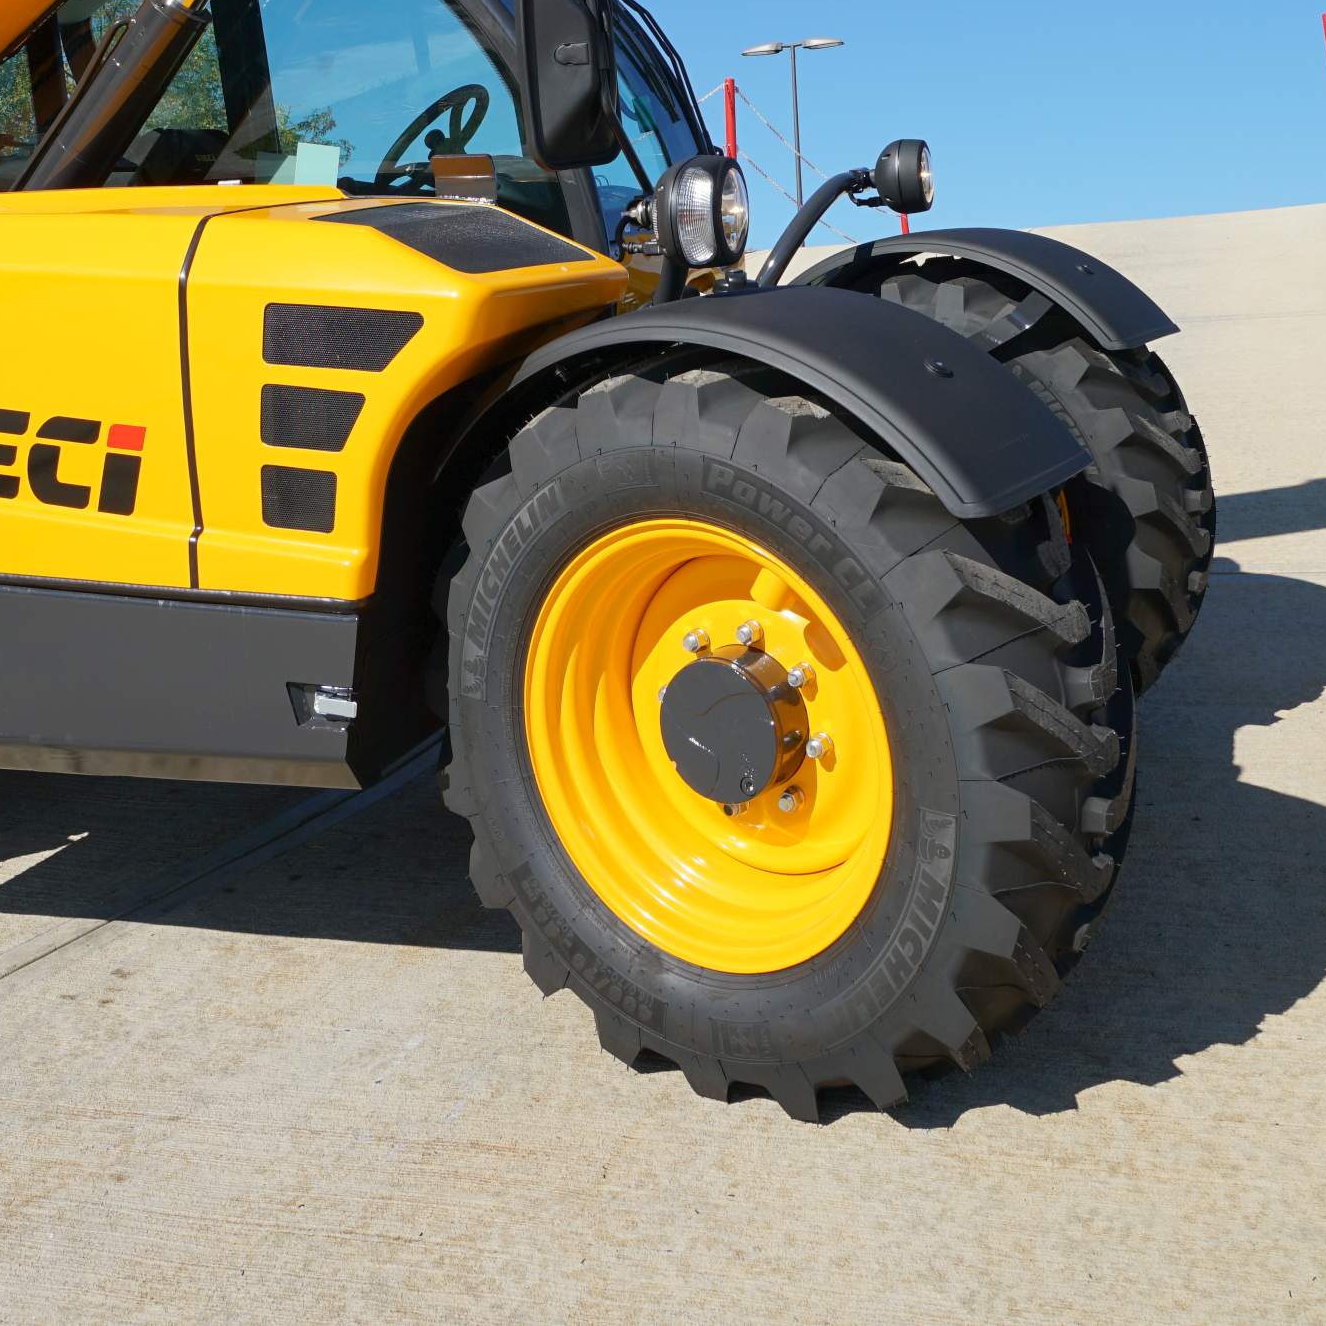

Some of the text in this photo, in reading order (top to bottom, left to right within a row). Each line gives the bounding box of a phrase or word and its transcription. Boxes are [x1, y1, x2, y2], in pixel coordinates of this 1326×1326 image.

[467, 482, 561, 651] MICHELIN
[706, 463, 876, 609] Power CL
